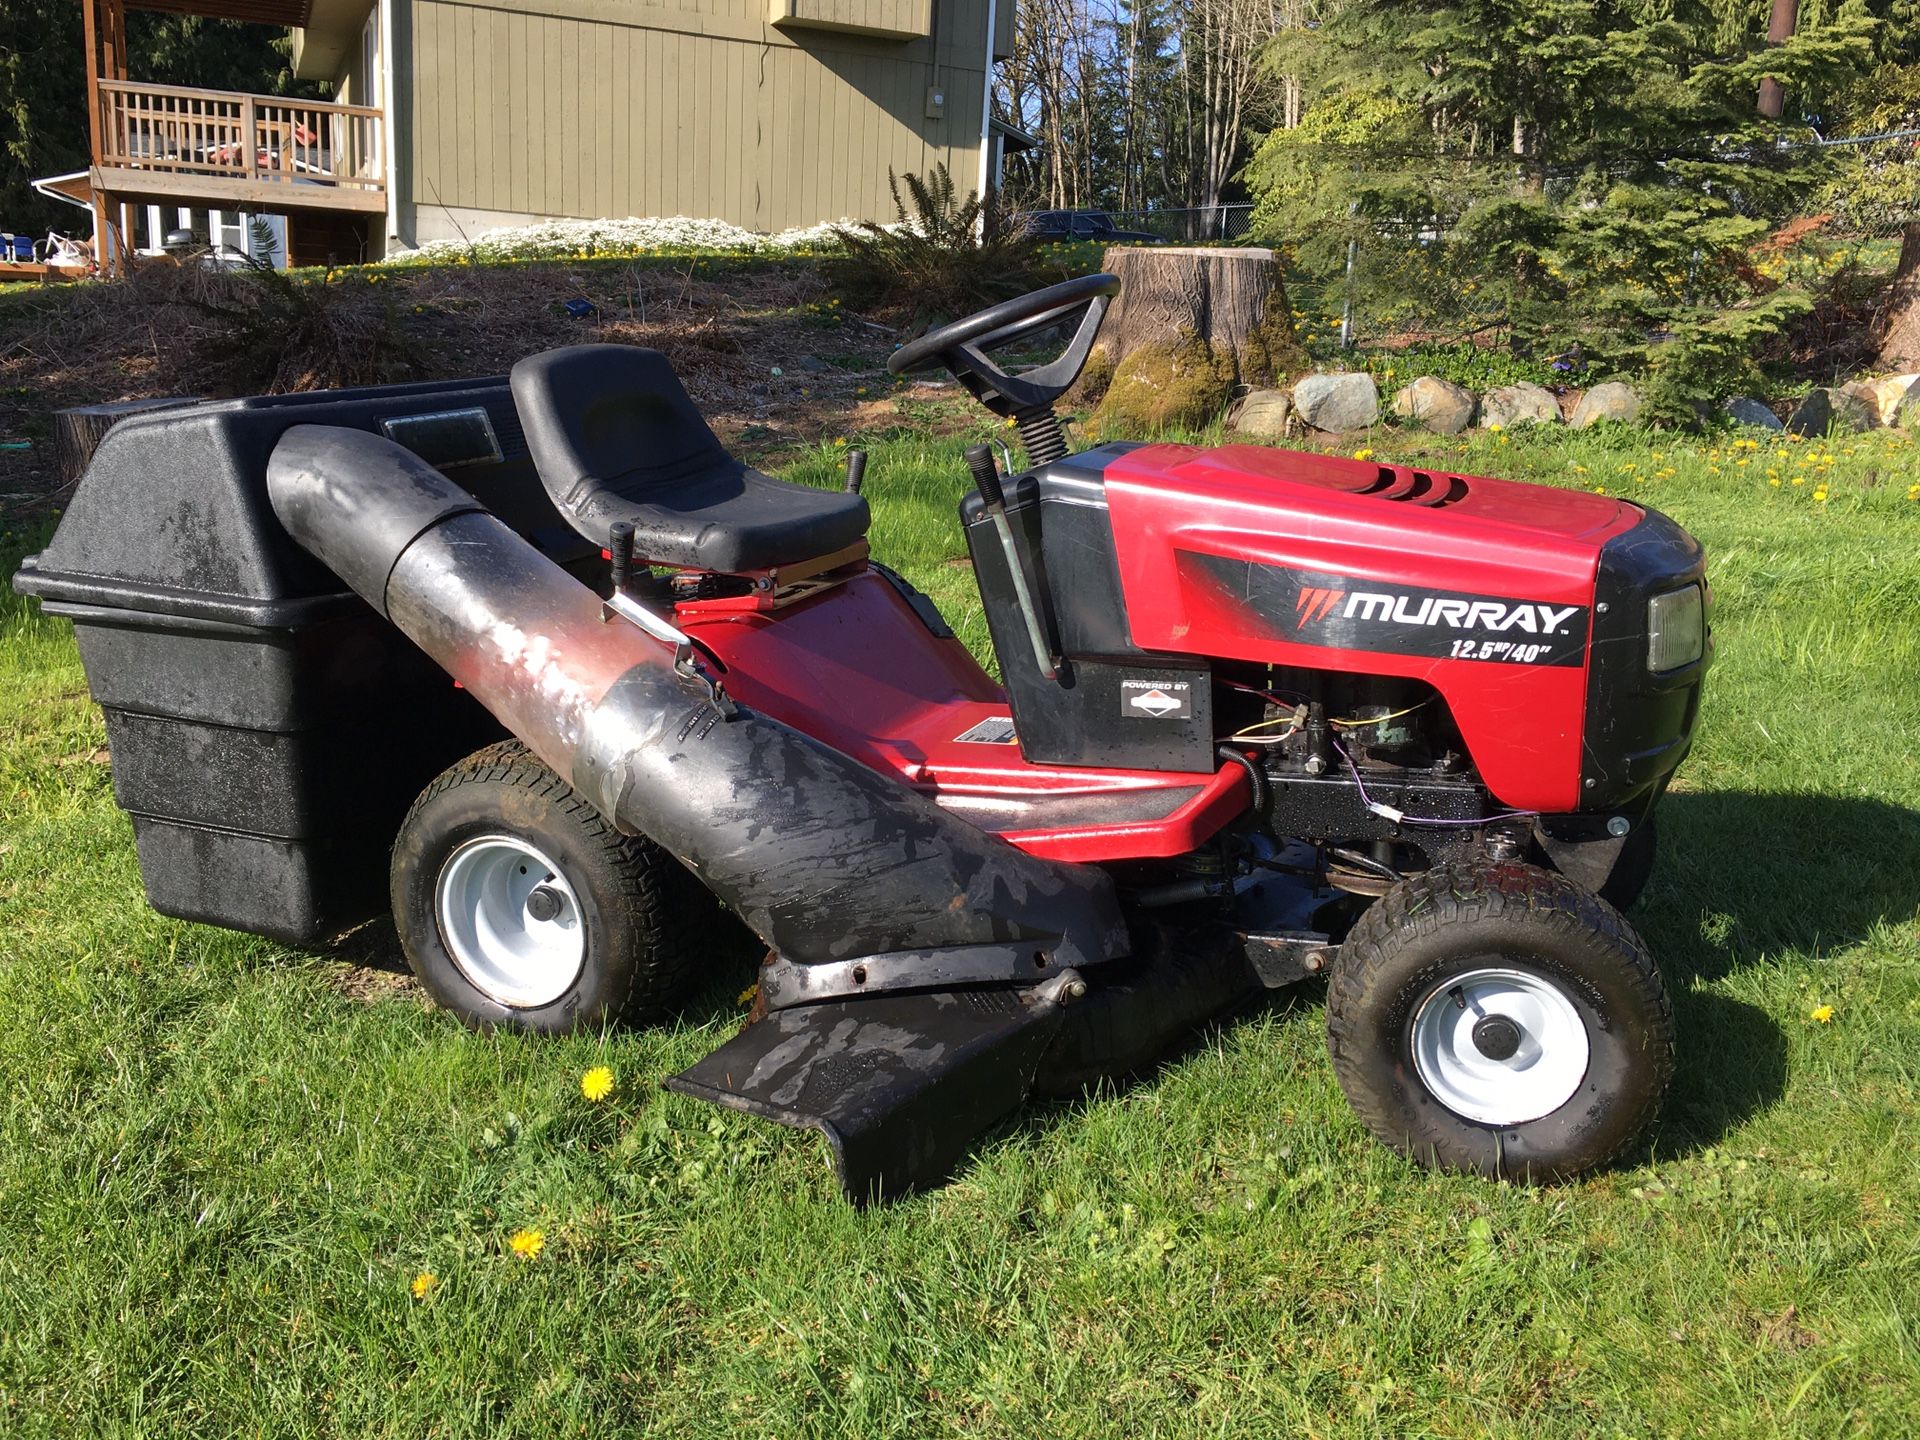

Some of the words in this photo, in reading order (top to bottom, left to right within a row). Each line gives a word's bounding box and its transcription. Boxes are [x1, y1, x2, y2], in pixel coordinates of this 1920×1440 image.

[1343, 591, 1580, 635] MURRAY
[1122, 681, 1172, 690] POWERED
[1174, 683, 1189, 691] BY
